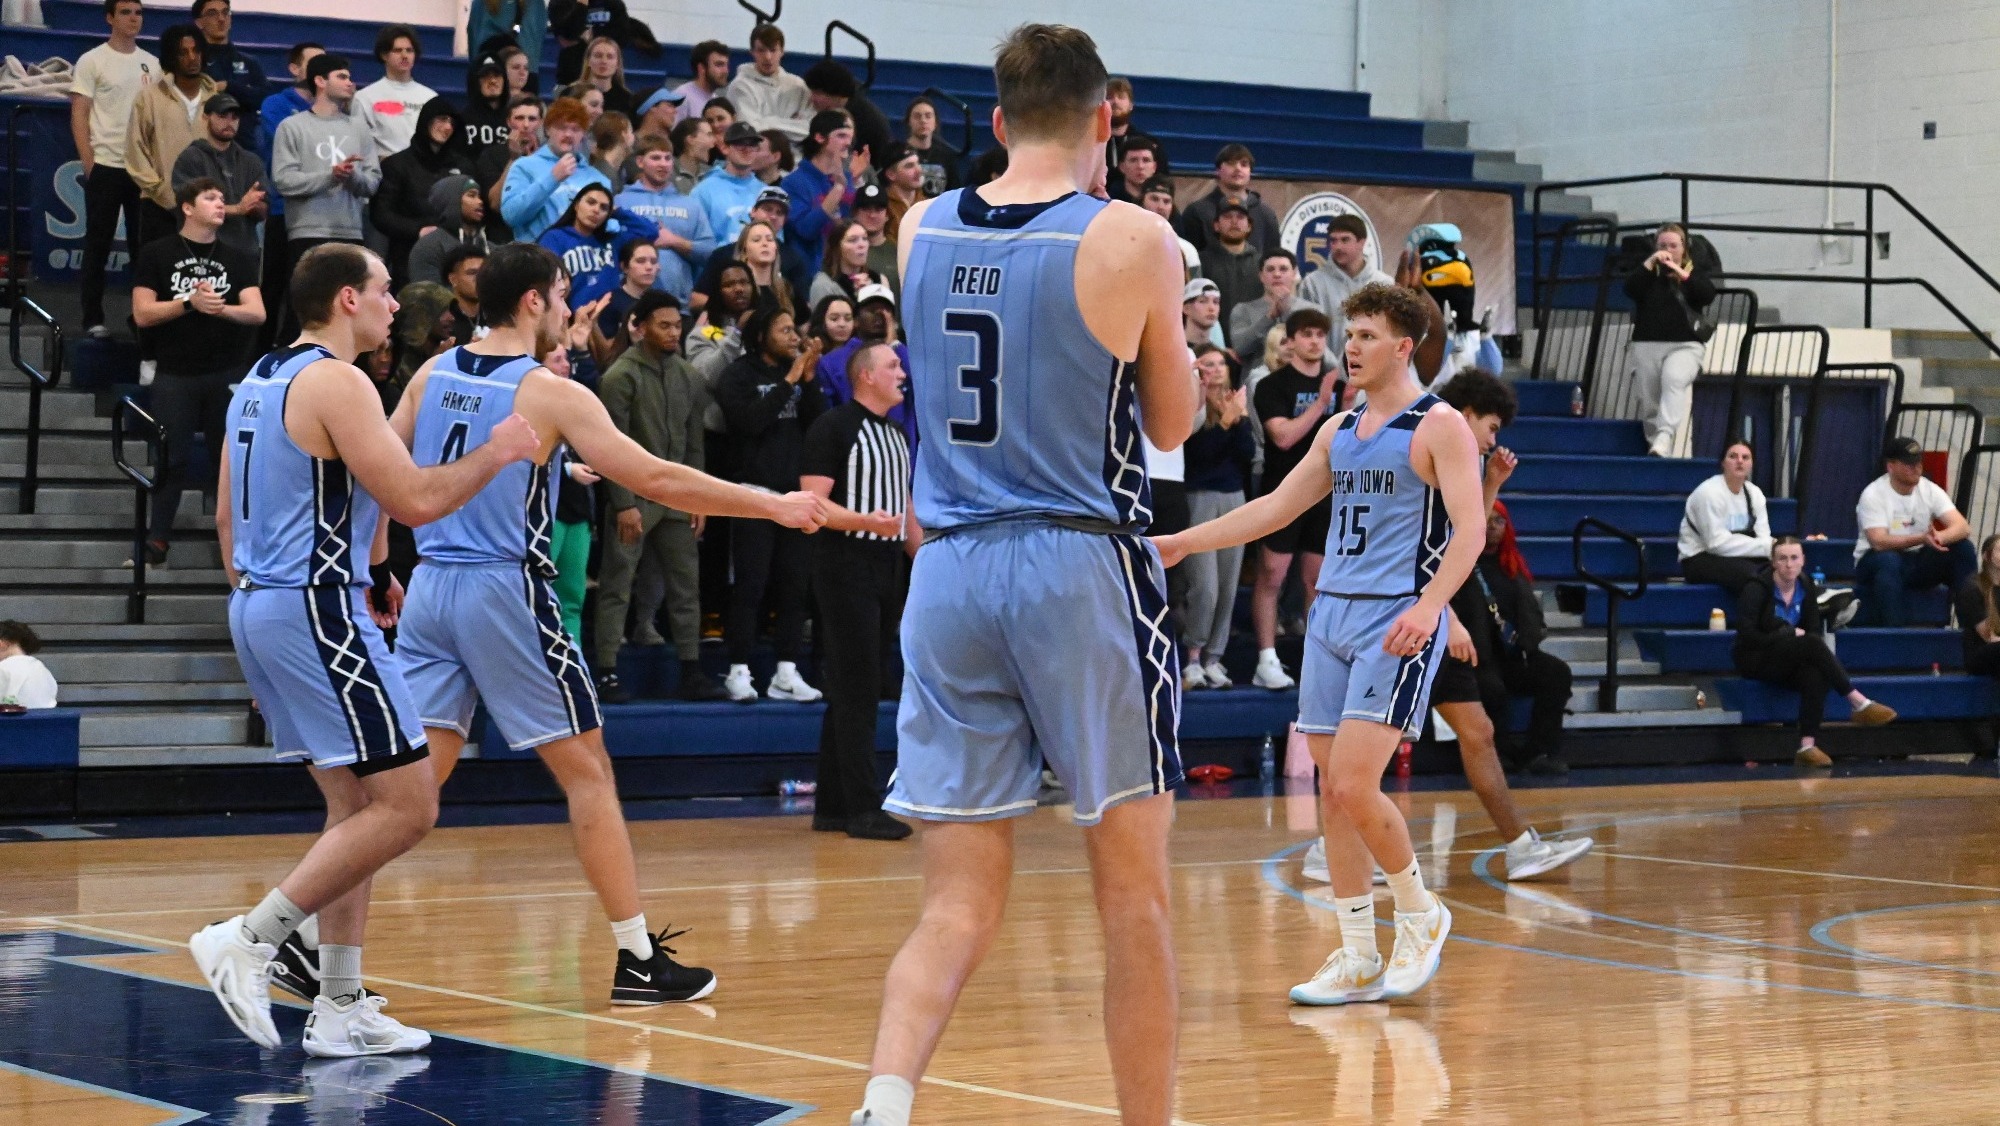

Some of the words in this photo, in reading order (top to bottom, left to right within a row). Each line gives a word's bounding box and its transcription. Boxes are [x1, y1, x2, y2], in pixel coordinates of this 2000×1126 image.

[1299, 202, 1347, 221] DIVISION
[562, 243, 615, 277] DUKE
[951, 265, 1002, 297] REID
[942, 308, 1003, 447] 3
[236, 428, 256, 523] 7
[1359, 468, 1395, 495] IOWA
[1336, 504, 1371, 557] 15
